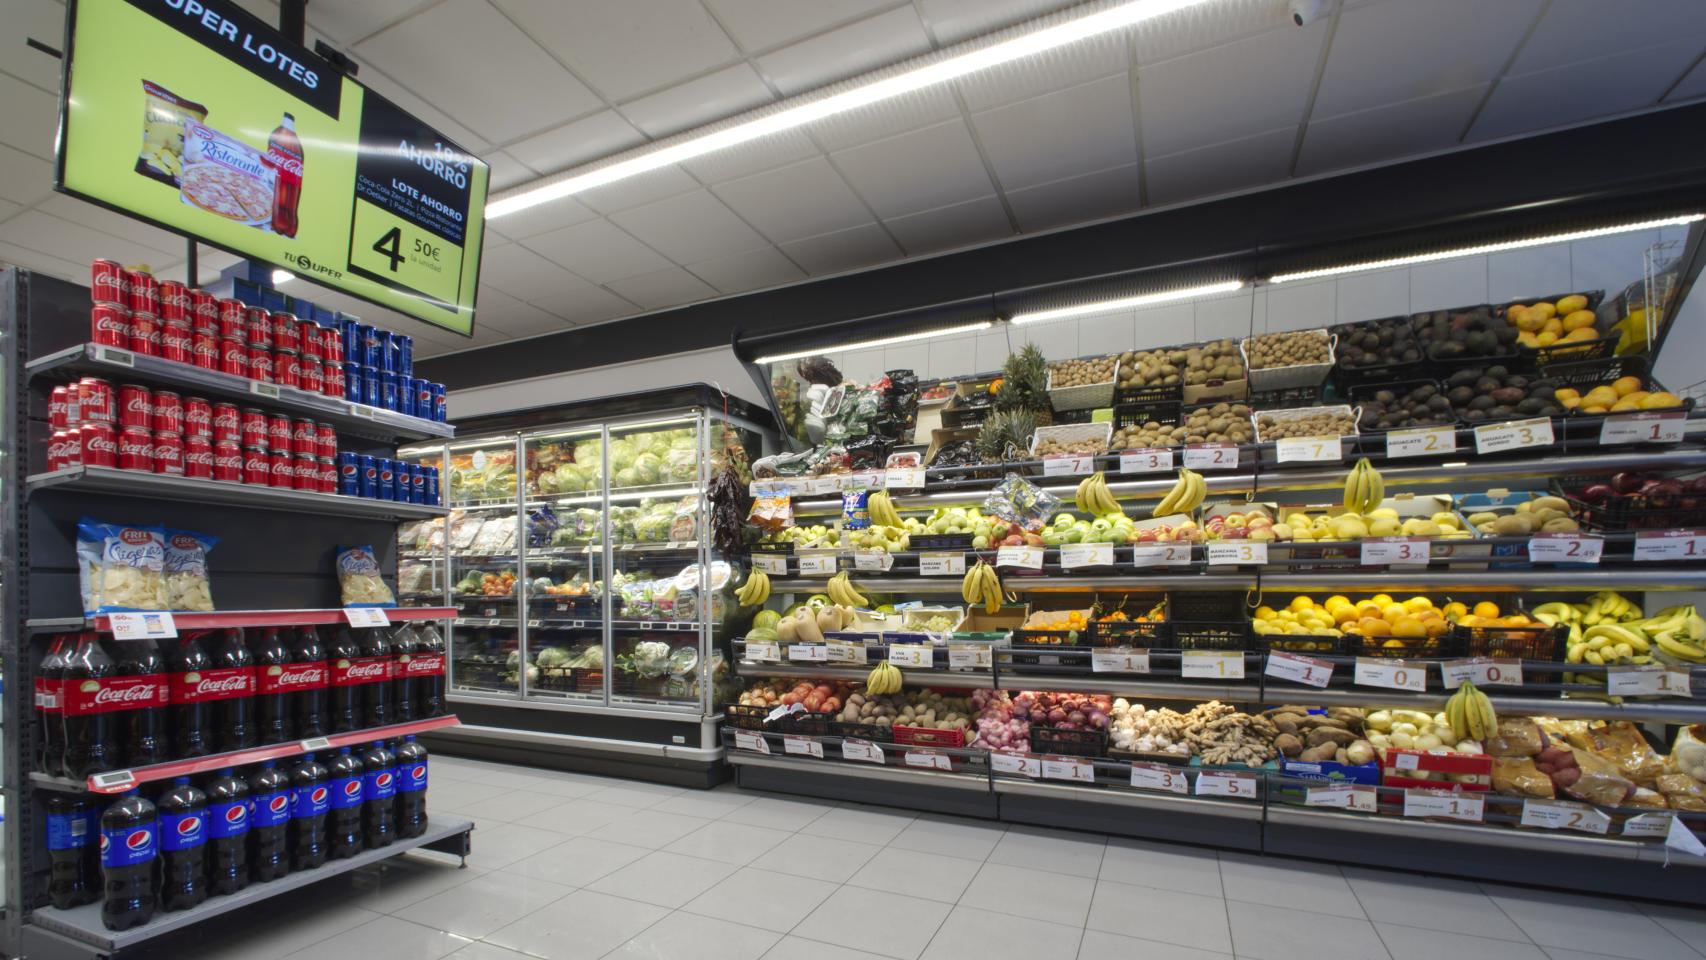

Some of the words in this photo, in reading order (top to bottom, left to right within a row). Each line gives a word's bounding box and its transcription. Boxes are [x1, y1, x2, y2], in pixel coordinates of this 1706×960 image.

[242, 33, 320, 89] LOTES
[200, 140, 265, 177] Ristorante
[268, 148, 303, 177] Coca-Cola
[398, 140, 467, 190] AHORRO
[358, 174, 391, 196] Coca-Cola
[391, 188, 406, 205] Zero
[391, 177, 419, 200] LOTE
[420, 193, 463, 222] AHORRO
[372, 226, 405, 273] 4
[414, 238, 440, 262] 50€
[419, 256, 442, 273] unidad
[1481, 432, 1515, 444] AGUACATE
[1649, 423, 1678, 440] 1.95
[1388, 438, 1422, 446] AGUACATE
[1398, 544, 1424, 559] 3.25
[1566, 541, 1595, 556] 2.49
[346, 663, 385, 678] Coca-Cola
[407, 658, 441, 672] Coca-Cola
[197, 675, 248, 694] Coca-Cola
[278, 668, 322, 686] Coca-Cola
[95, 684, 156, 704] Coca-Cola
